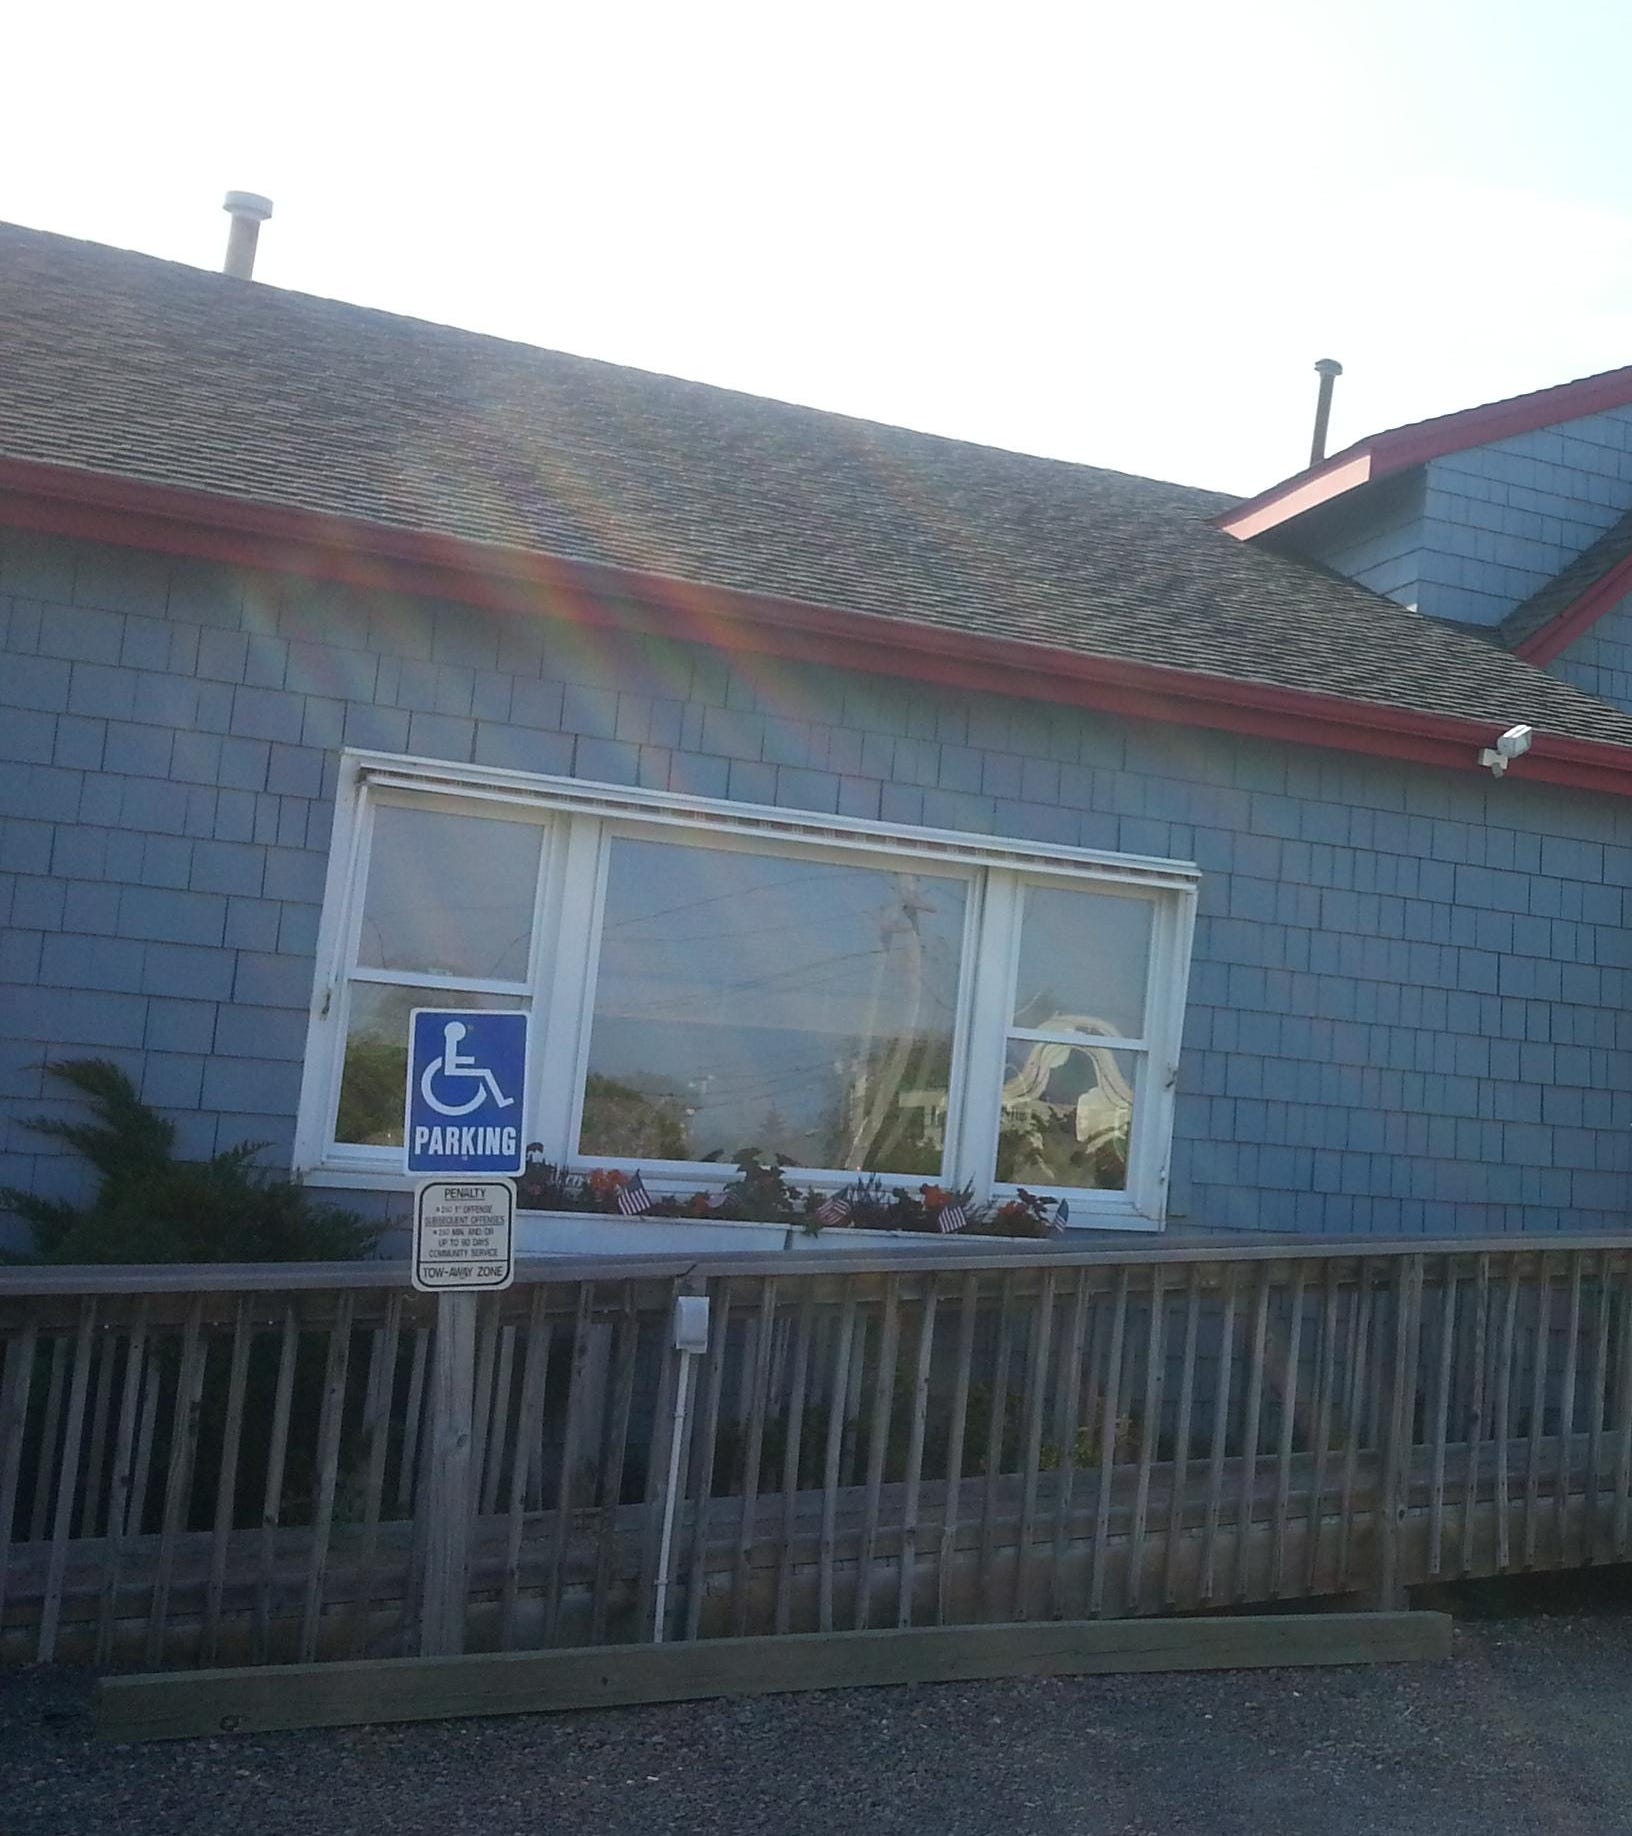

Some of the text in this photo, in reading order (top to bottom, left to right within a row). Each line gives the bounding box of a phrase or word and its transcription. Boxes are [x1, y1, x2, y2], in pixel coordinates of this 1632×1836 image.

[414, 1125, 517, 1156] PARKING
[444, 1187, 486, 1199] PENALTY
[463, 1204, 493, 1214] OFFENSE
[424, 1215, 505, 1226] SUBSEQUENT OFFENSES
[438, 1239, 449, 1247] UP
[450, 1239, 460, 1247] TO
[472, 1238, 490, 1247] DAYS
[428, 1248, 499, 1258] COMMUNITY SERVICE
[423, 1265, 504, 1279] TOW-AWAY ZONE
